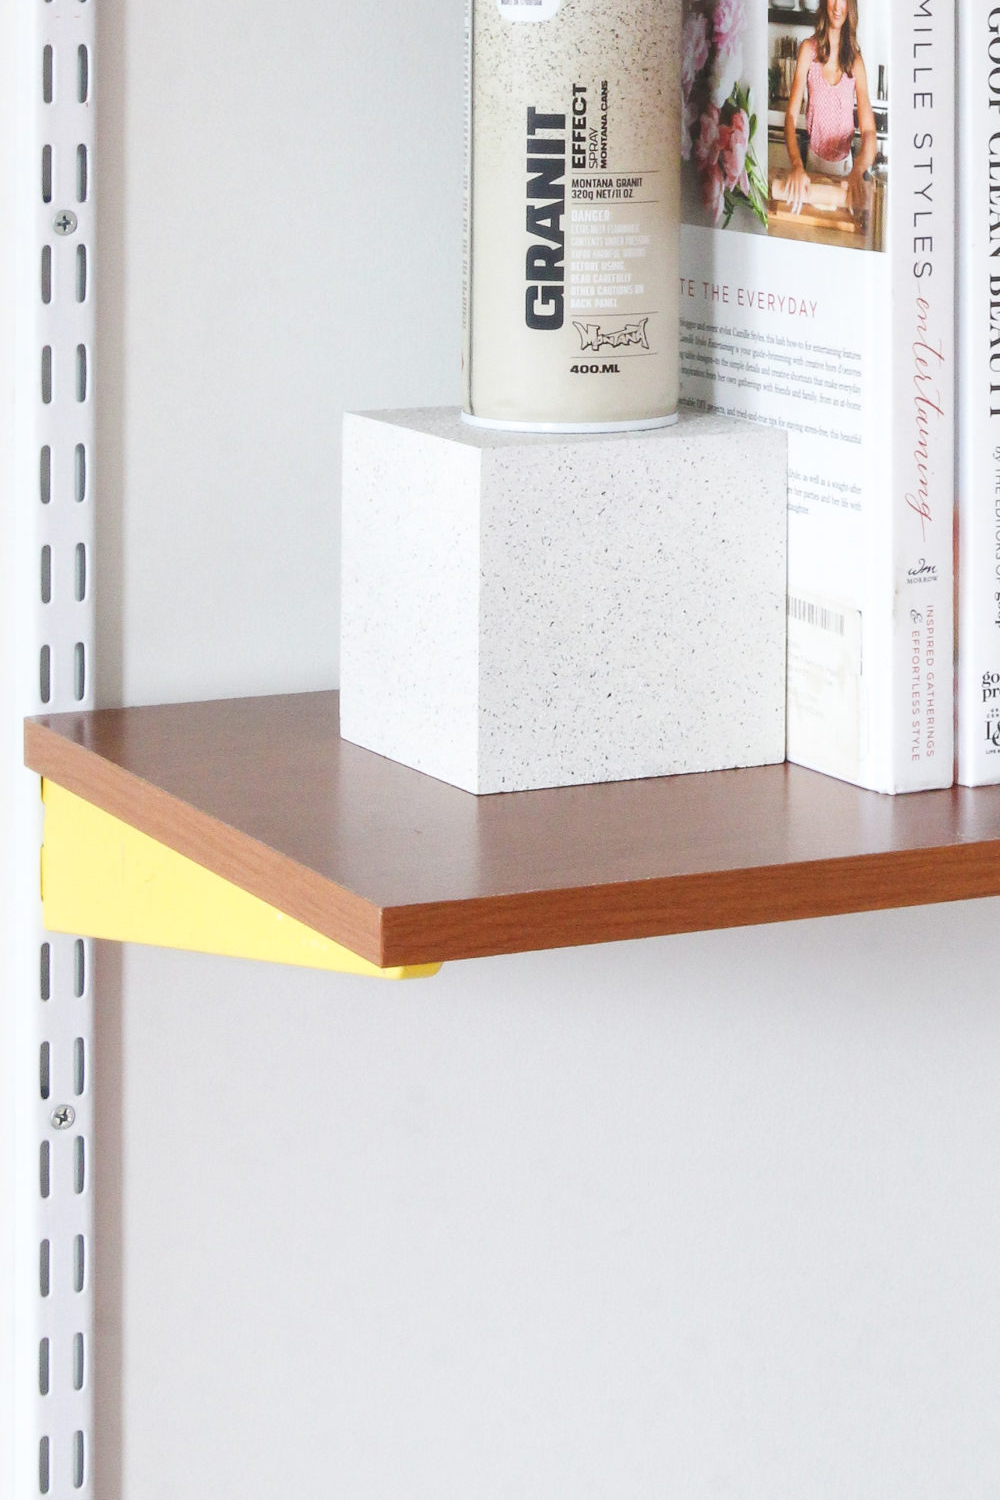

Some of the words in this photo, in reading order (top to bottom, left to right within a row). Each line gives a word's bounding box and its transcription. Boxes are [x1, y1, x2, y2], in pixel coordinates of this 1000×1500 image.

[572, 83, 587, 168] EFFECT
[589, 128, 598, 168] SPRAY
[572, 179, 613, 188] MONTANA
[616, 178, 642, 187] GRANIT
[572, 189, 594, 200] 320g
[913, 133, 932, 278] STYLES
[525, 106, 565, 330] GRANIT
[702, 282, 729, 303] THE
[737, 288, 818, 318] EVERYDAY
[570, 364, 620, 374] 400.ML
[905, 290, 944, 541] entertaining
[926, 605, 934, 666] INSPIRED
[912, 631, 920, 715] EFFORTLESS
[912, 721, 920, 761] STYLE
[926, 672, 934, 757] GATHERINGS
